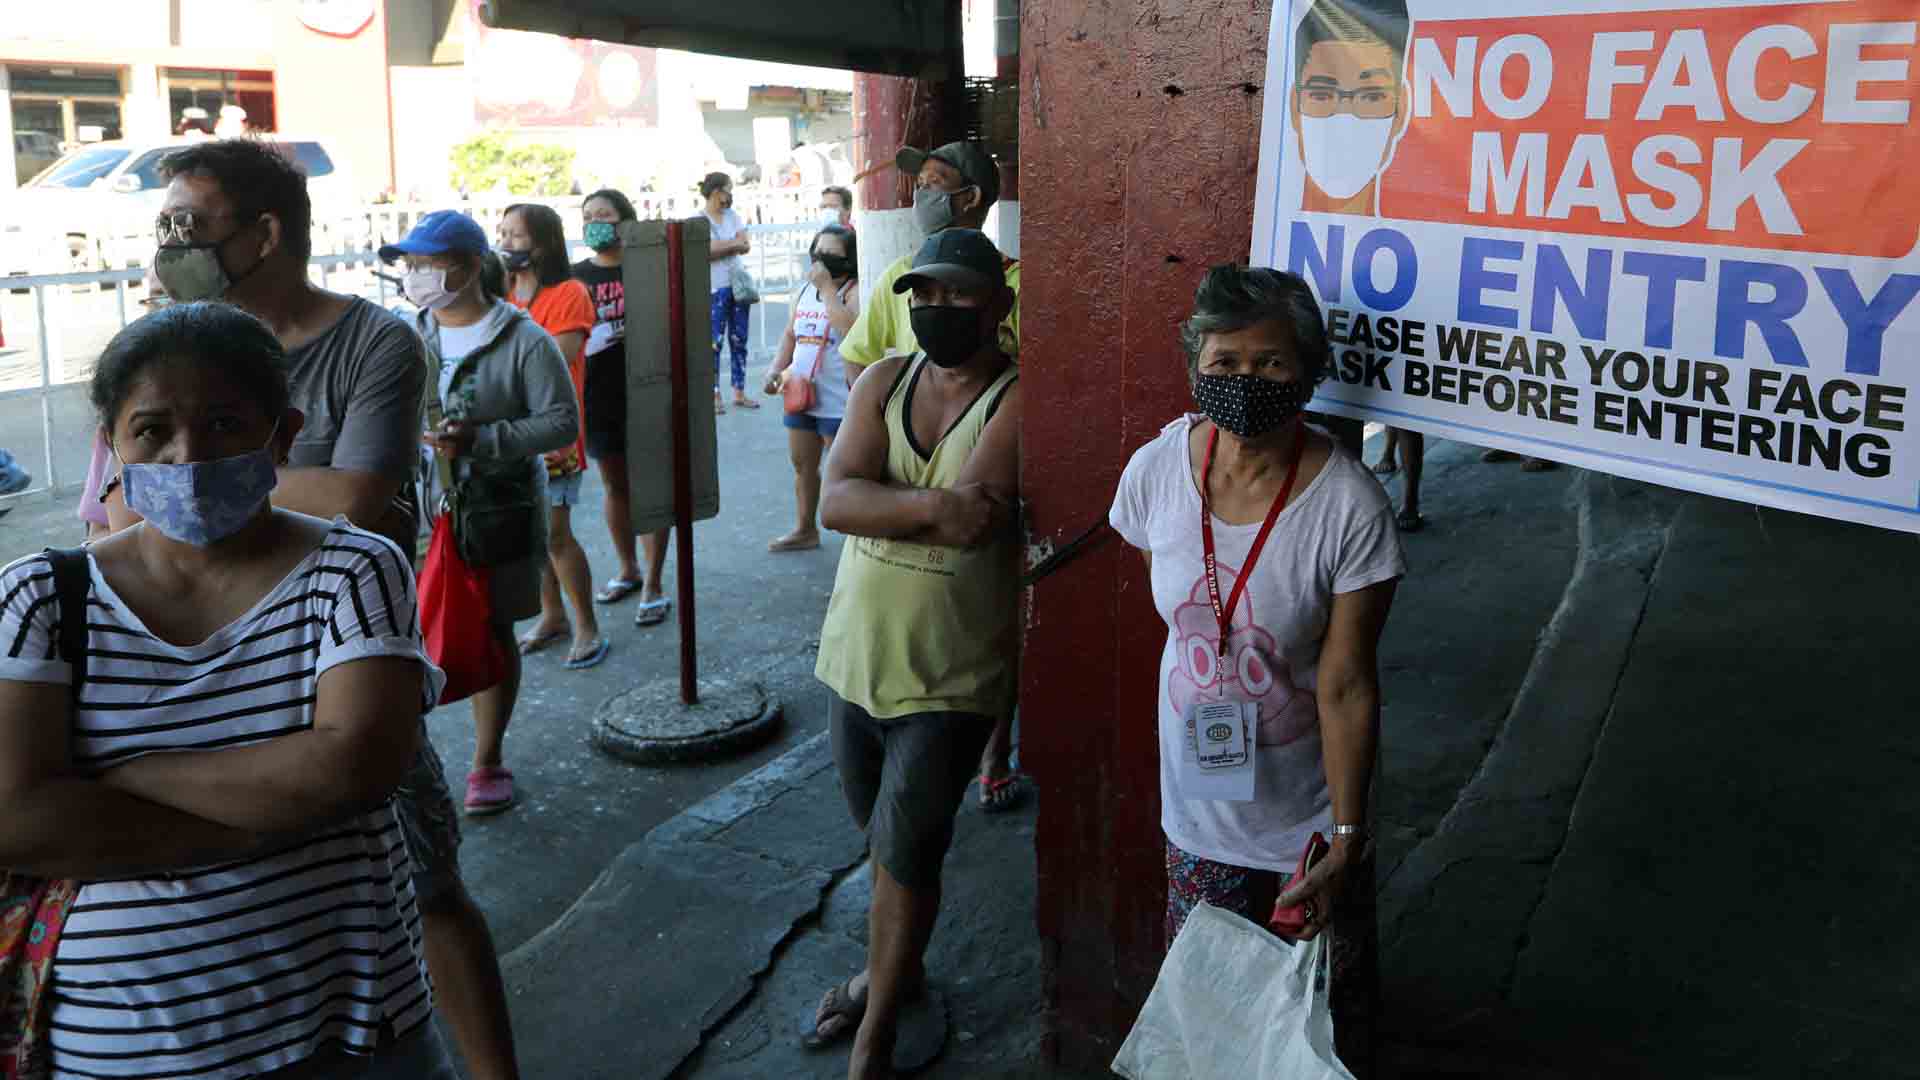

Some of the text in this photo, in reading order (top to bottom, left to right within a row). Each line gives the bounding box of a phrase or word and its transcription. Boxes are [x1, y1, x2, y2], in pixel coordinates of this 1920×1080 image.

[1414, 22, 1917, 125] NO FACE
[1467, 131, 1812, 235] MASK
[1288, 221, 1920, 377] NO ENTRY
[1318, 345, 1892, 478] ASK BEFORE ENTERING
[1326, 309, 1907, 432] EASE WEAR YOUR FACE
